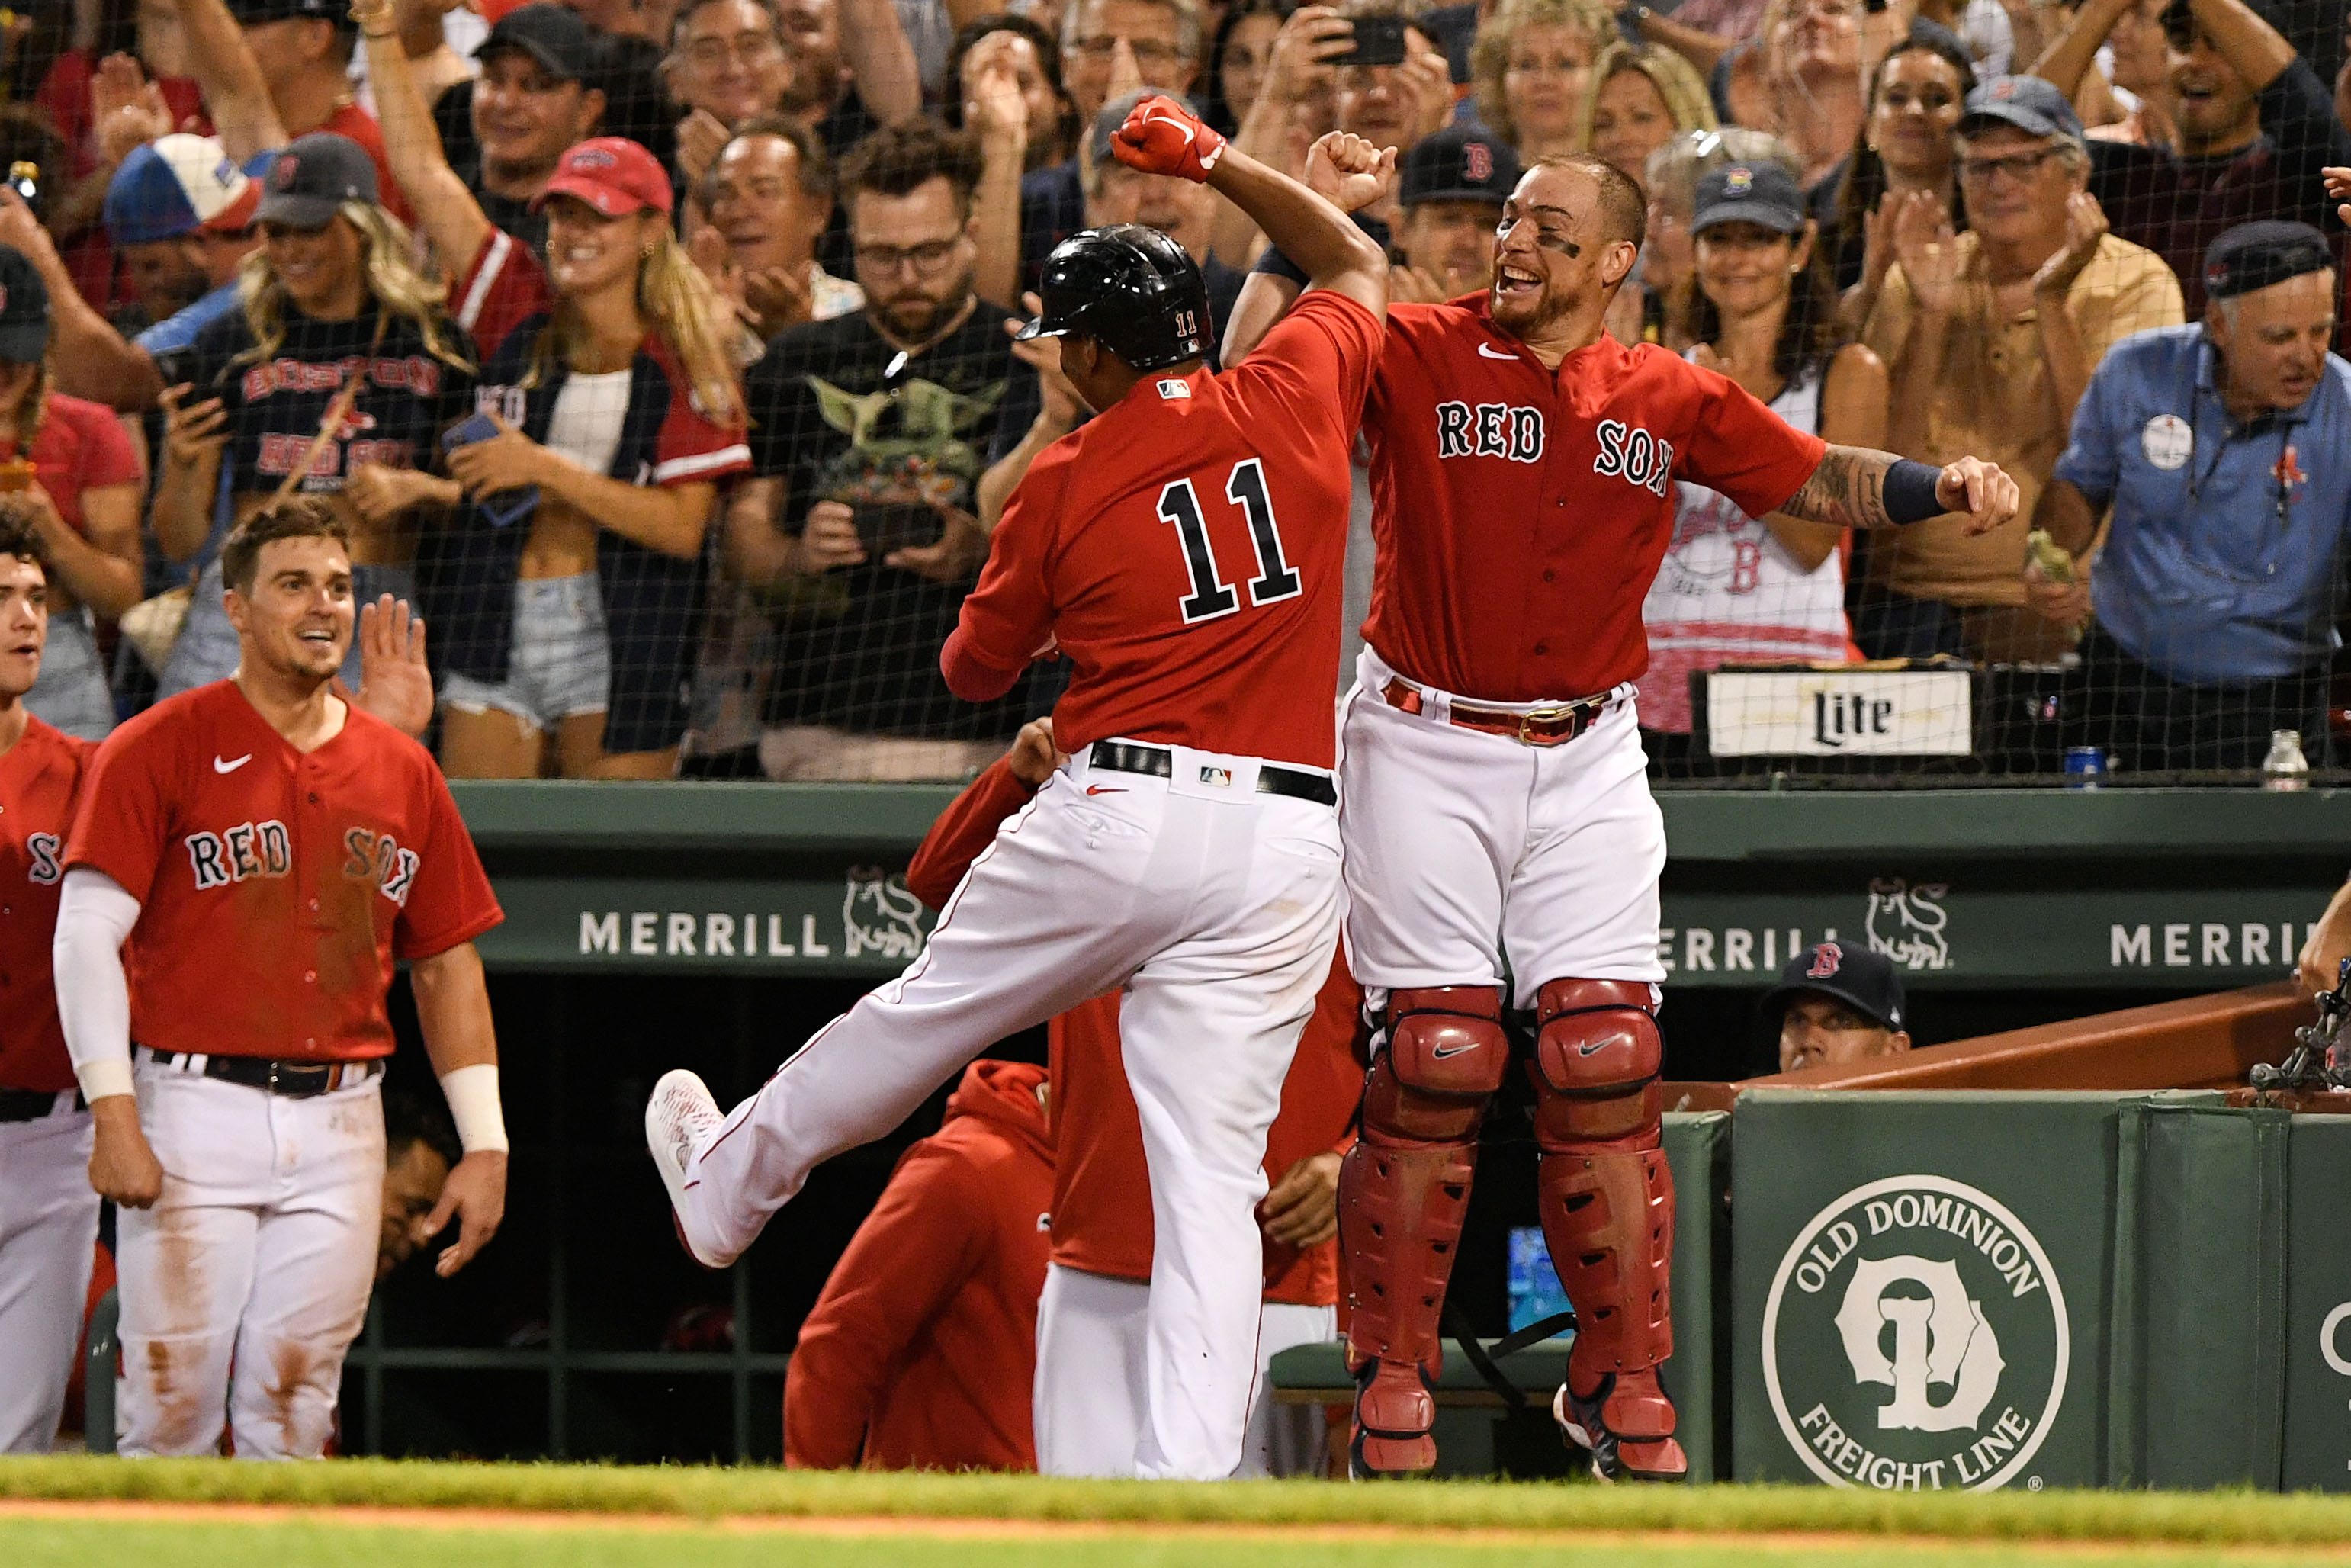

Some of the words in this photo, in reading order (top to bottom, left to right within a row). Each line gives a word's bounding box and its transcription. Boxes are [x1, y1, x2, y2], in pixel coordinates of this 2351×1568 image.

[1464, 143, 1493, 180] B
[1175, 310, 1197, 337] 11
[1435, 400, 1545, 463] RED
[1593, 419, 1674, 497] SOX
[1155, 457, 1303, 625] 11
[1726, 540, 1762, 595] B
[1813, 689, 1893, 747] Lite
[185, 818, 292, 890] RED
[344, 826, 421, 908] SOX
[579, 911, 830, 958] MERRILL
[1806, 942, 1844, 979] B
[2110, 922, 2318, 967] MERRI
[1796, 1220, 1858, 1293] OLD
[1864, 1194, 2041, 1299] DOMINION
[1799, 1402, 1945, 1492] FREIGHT
[1952, 1406, 2031, 1485] LINE
